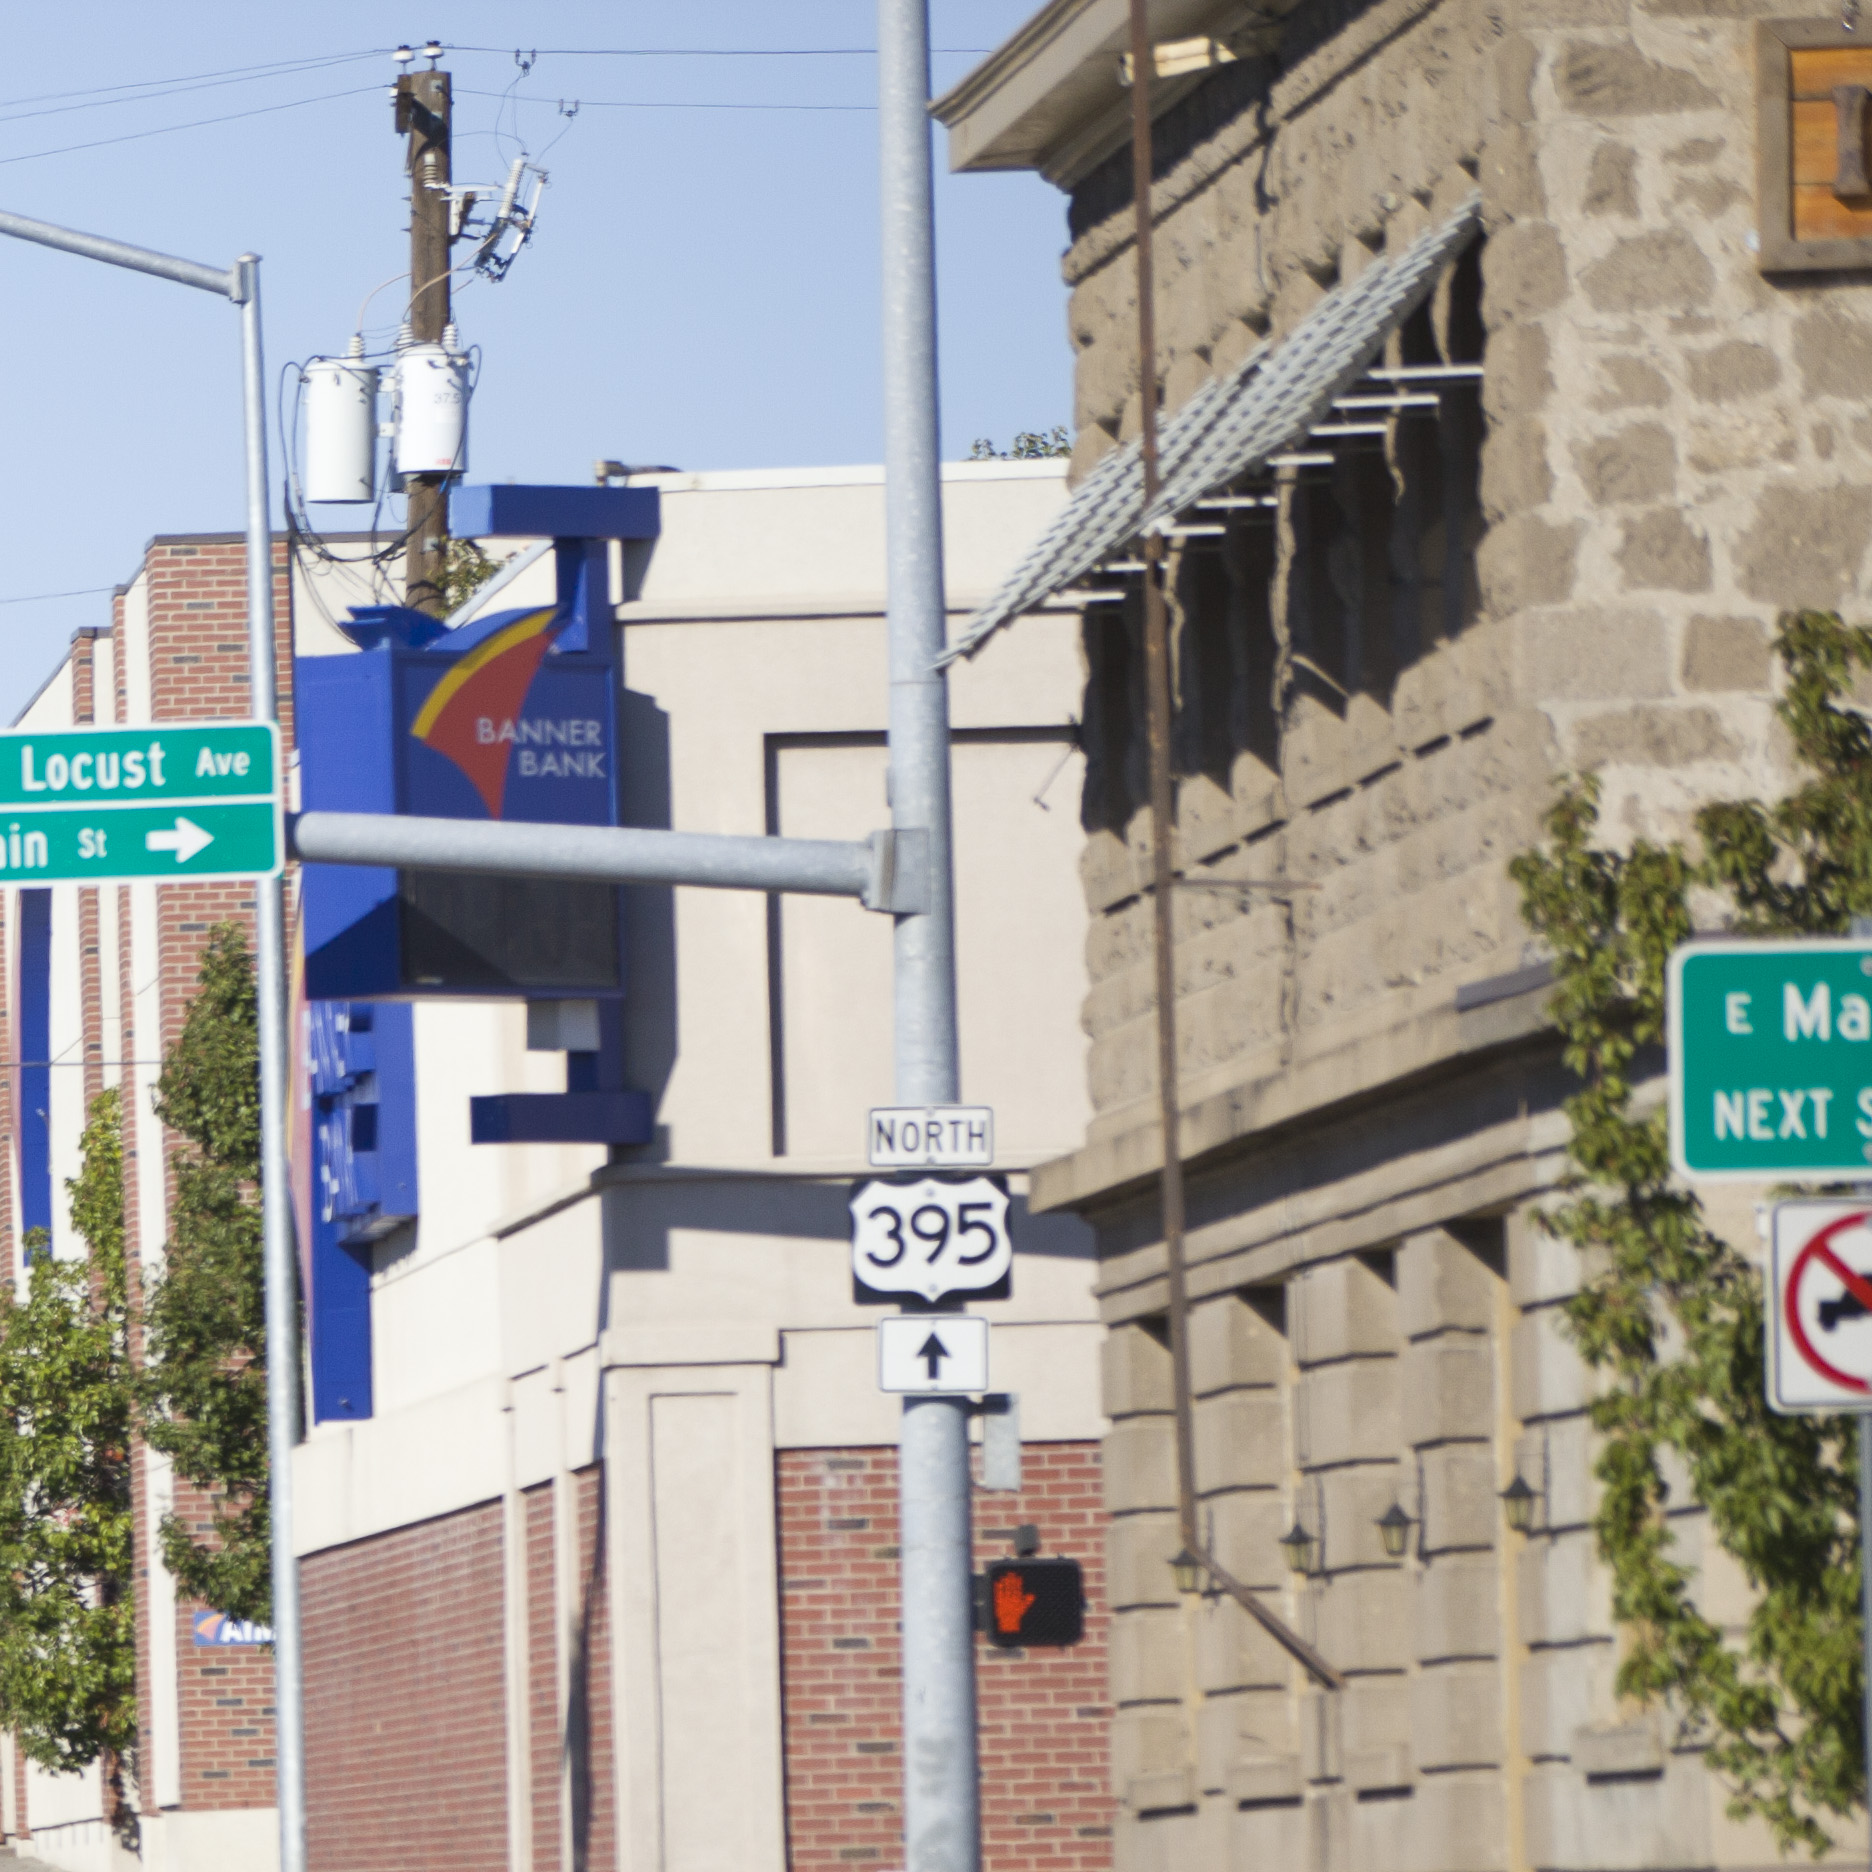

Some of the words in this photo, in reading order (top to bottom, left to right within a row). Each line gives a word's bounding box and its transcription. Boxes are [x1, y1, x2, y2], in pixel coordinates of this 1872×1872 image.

[476, 716, 602, 746] BANNER
[21, 741, 166, 791] Locust
[194, 746, 251, 777] Ave
[518, 750, 606, 778] BANK
[78, 828, 108, 858] St
[1724, 991, 1754, 1035] E
[1783, 980, 1872, 1043] Ma
[1713, 1087, 1834, 1141] NEXT
[875, 1118, 987, 1153] NORTH
[865, 1202, 997, 1268] 395
